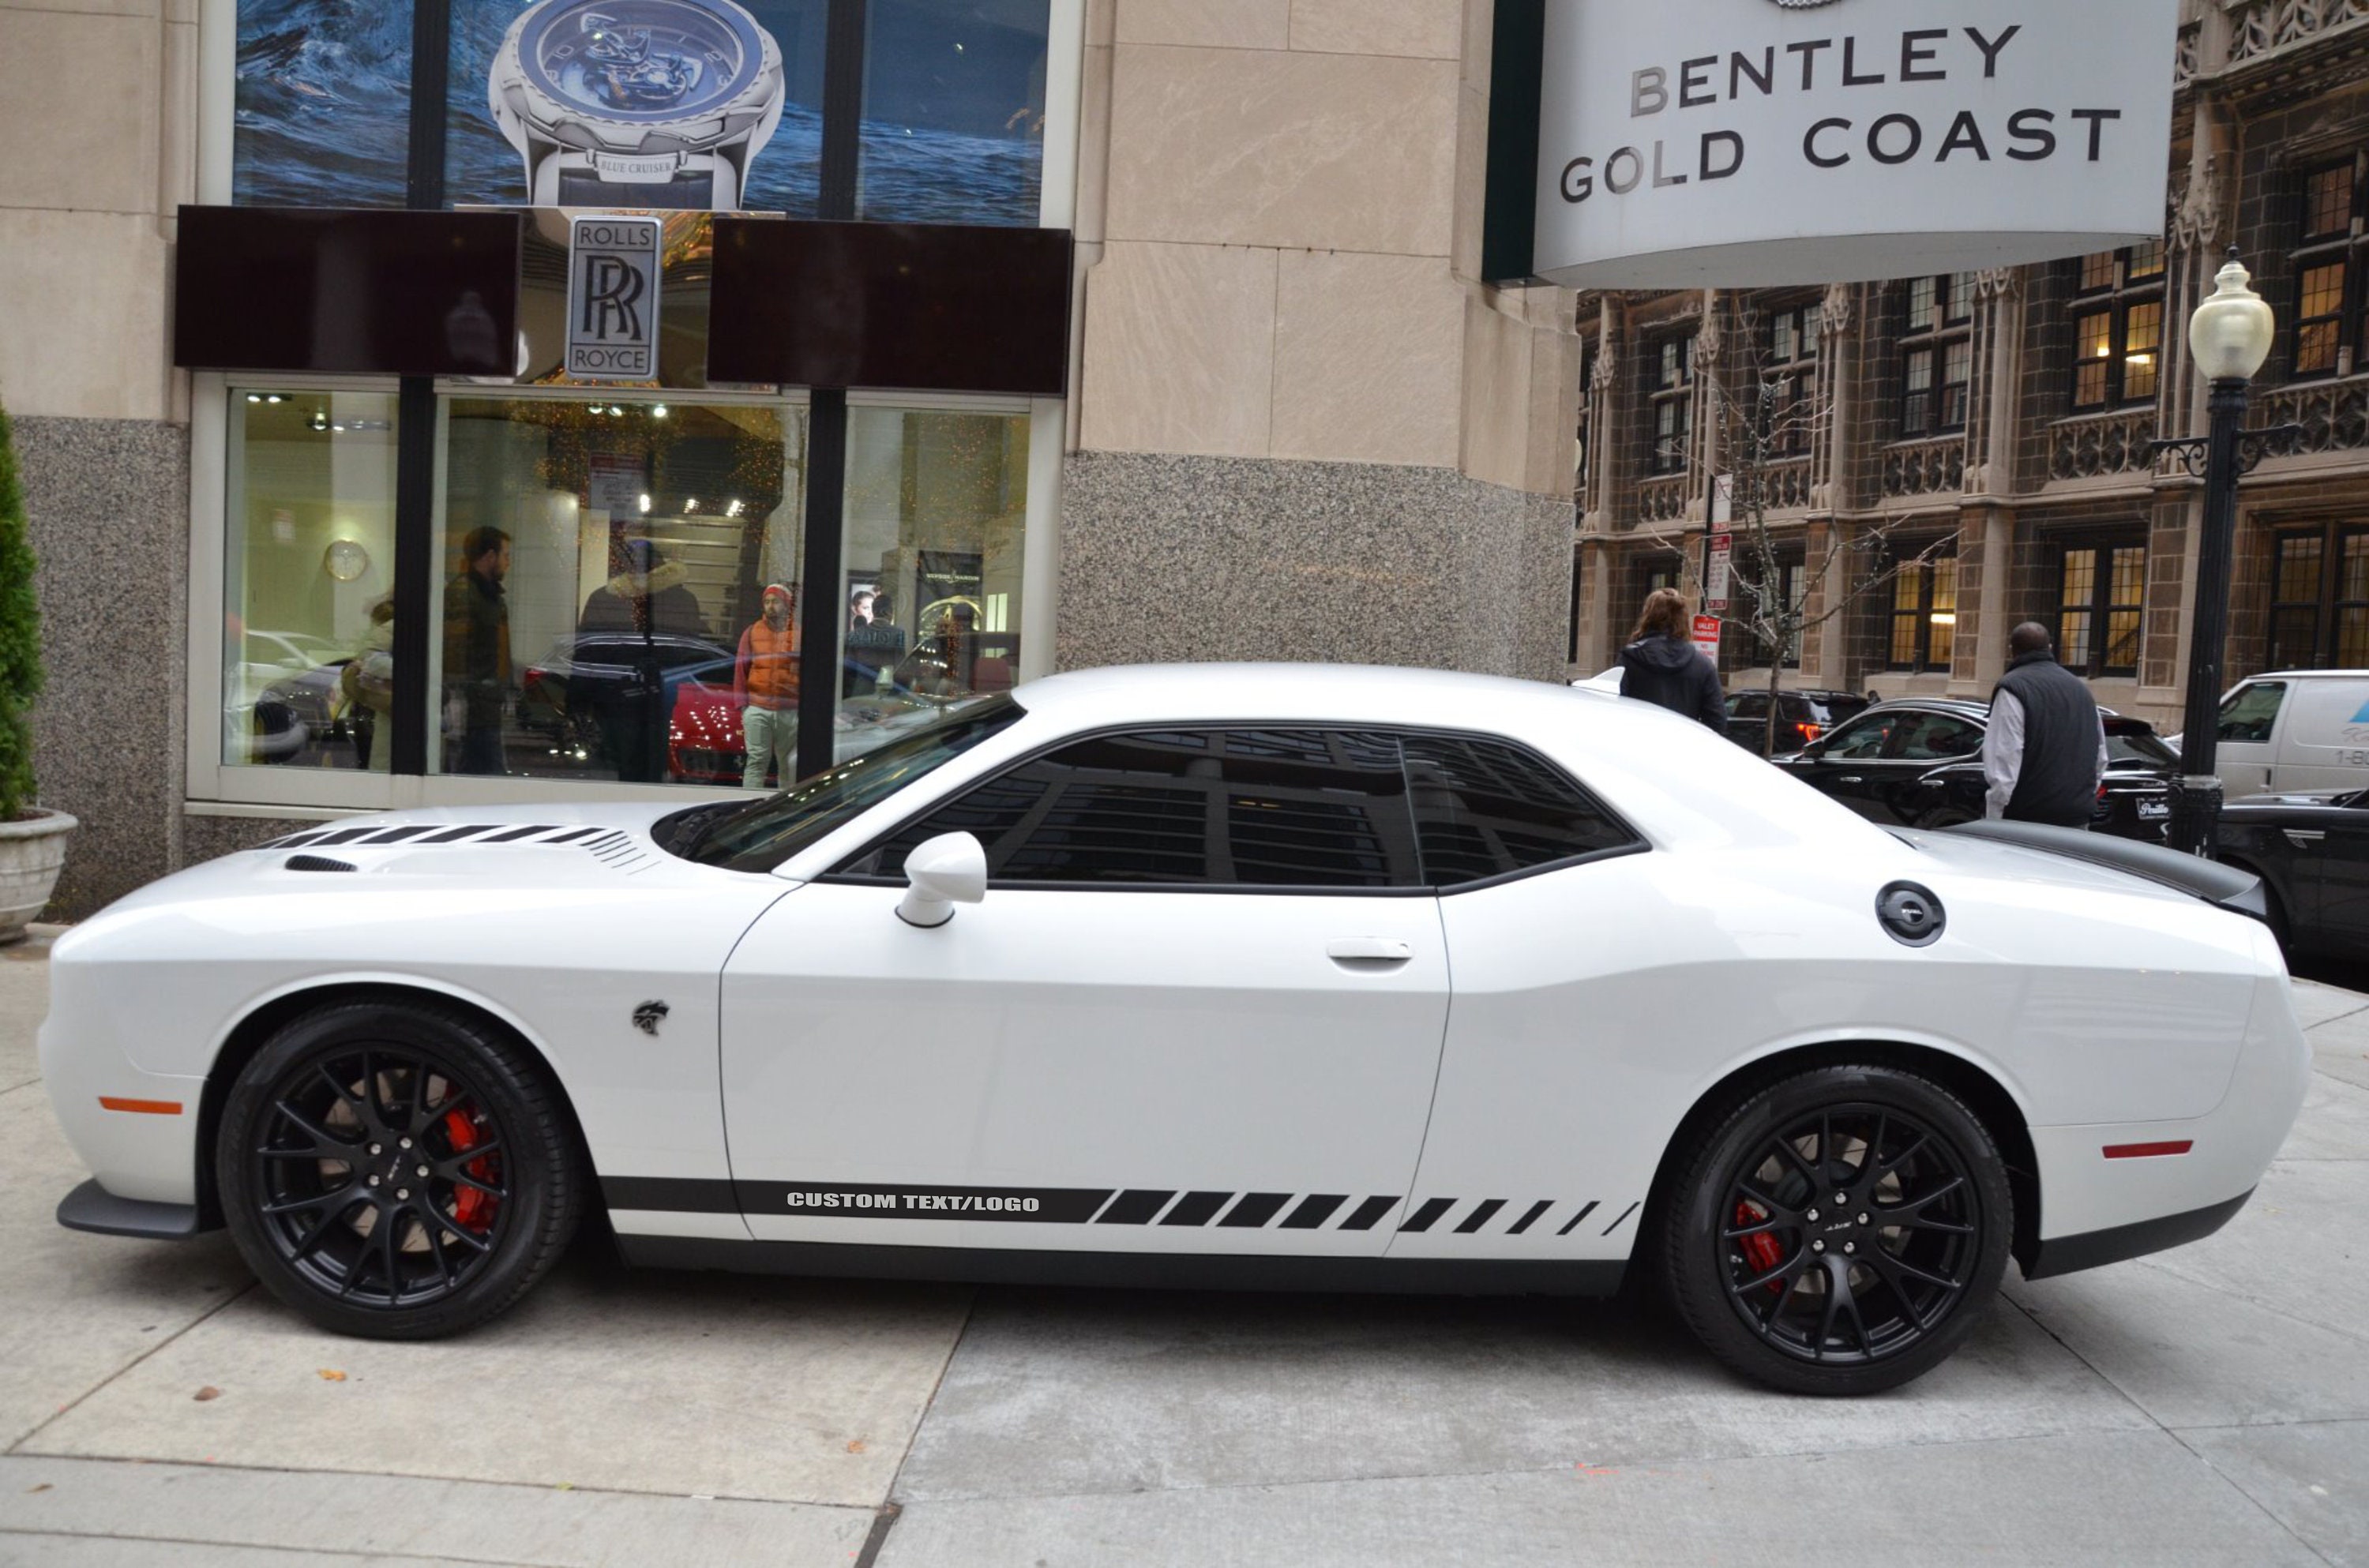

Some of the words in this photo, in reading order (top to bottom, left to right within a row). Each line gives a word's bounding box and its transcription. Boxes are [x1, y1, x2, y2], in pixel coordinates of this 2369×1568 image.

[1629, 24, 2022, 118] BENTLEY
[1560, 129, 1745, 204] GOLD
[1801, 107, 2121, 168] COAST
[600, 160, 626, 173] BLUE
[628, 162, 671, 174] CRUISER
[580, 226, 651, 246] ROLLS
[574, 349, 645, 369] ROYCE
[787, 1191, 896, 1210] CUSTOM
[903, 1194, 1040, 1213] TEXT/LOGO
